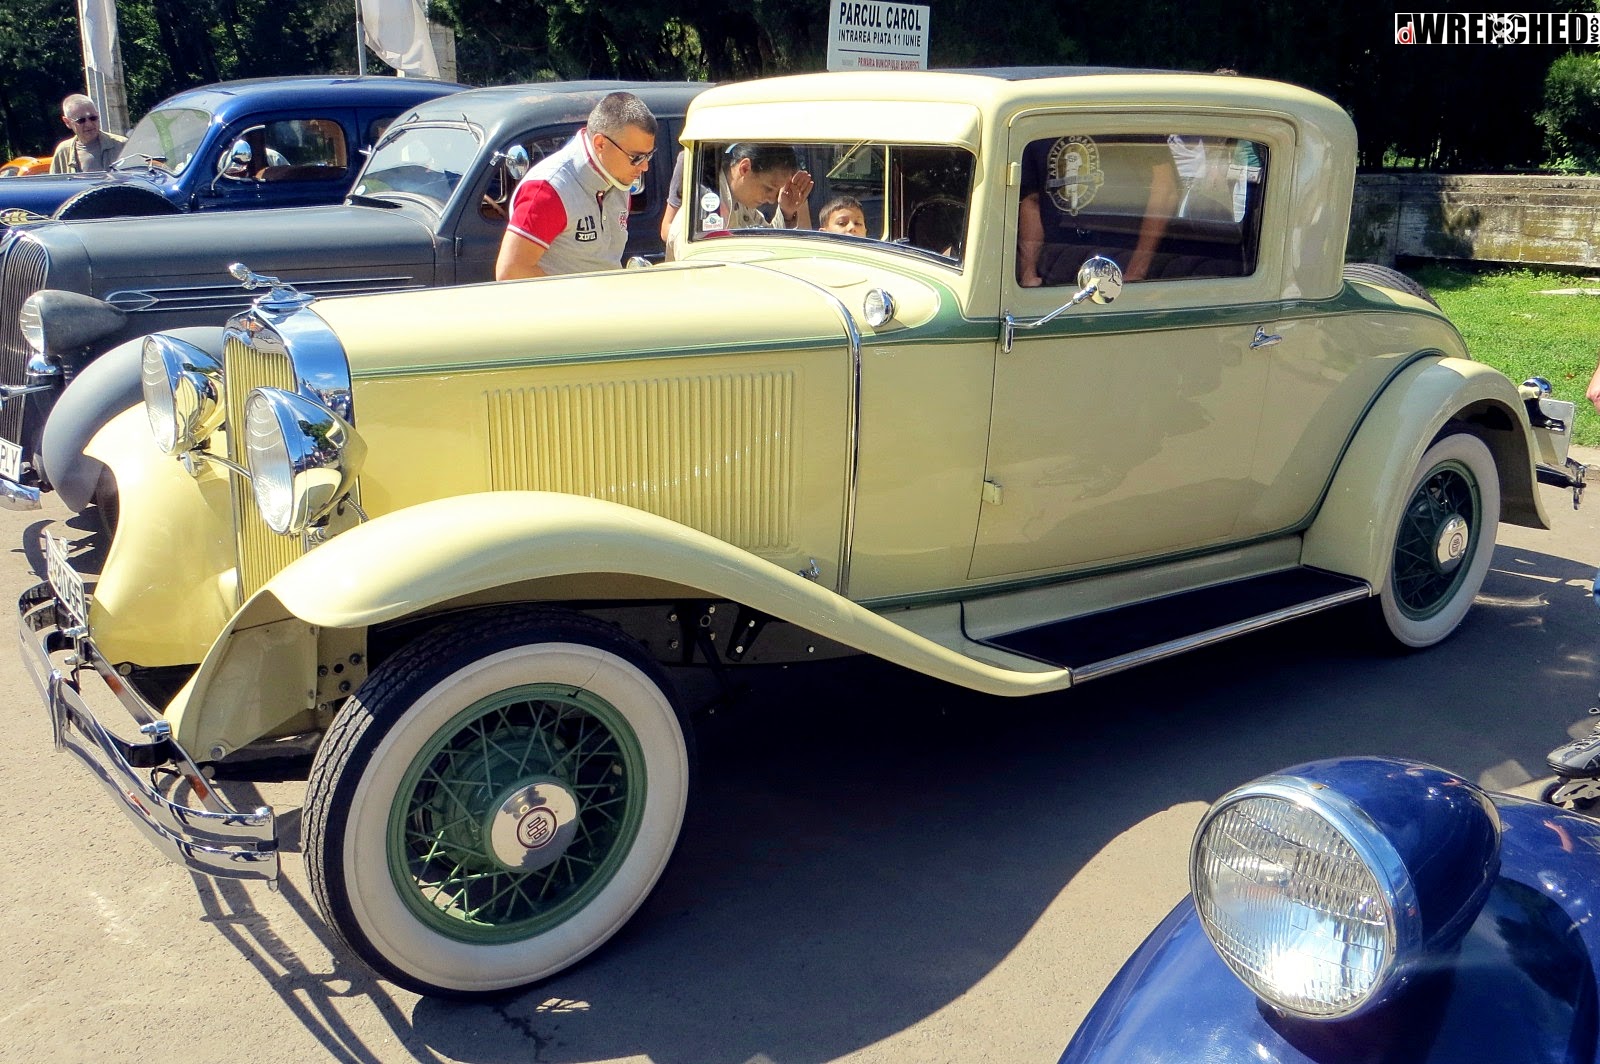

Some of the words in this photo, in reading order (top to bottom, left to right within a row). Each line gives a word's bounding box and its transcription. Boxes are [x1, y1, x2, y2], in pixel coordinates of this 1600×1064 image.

[840, 2, 882, 28] PARCUL
[886, 7, 921, 31] CAROL
[838, 29, 871, 44] INTRAREA
[894, 34, 901, 46] 11
[903, 35, 921, 47] IUNIE
